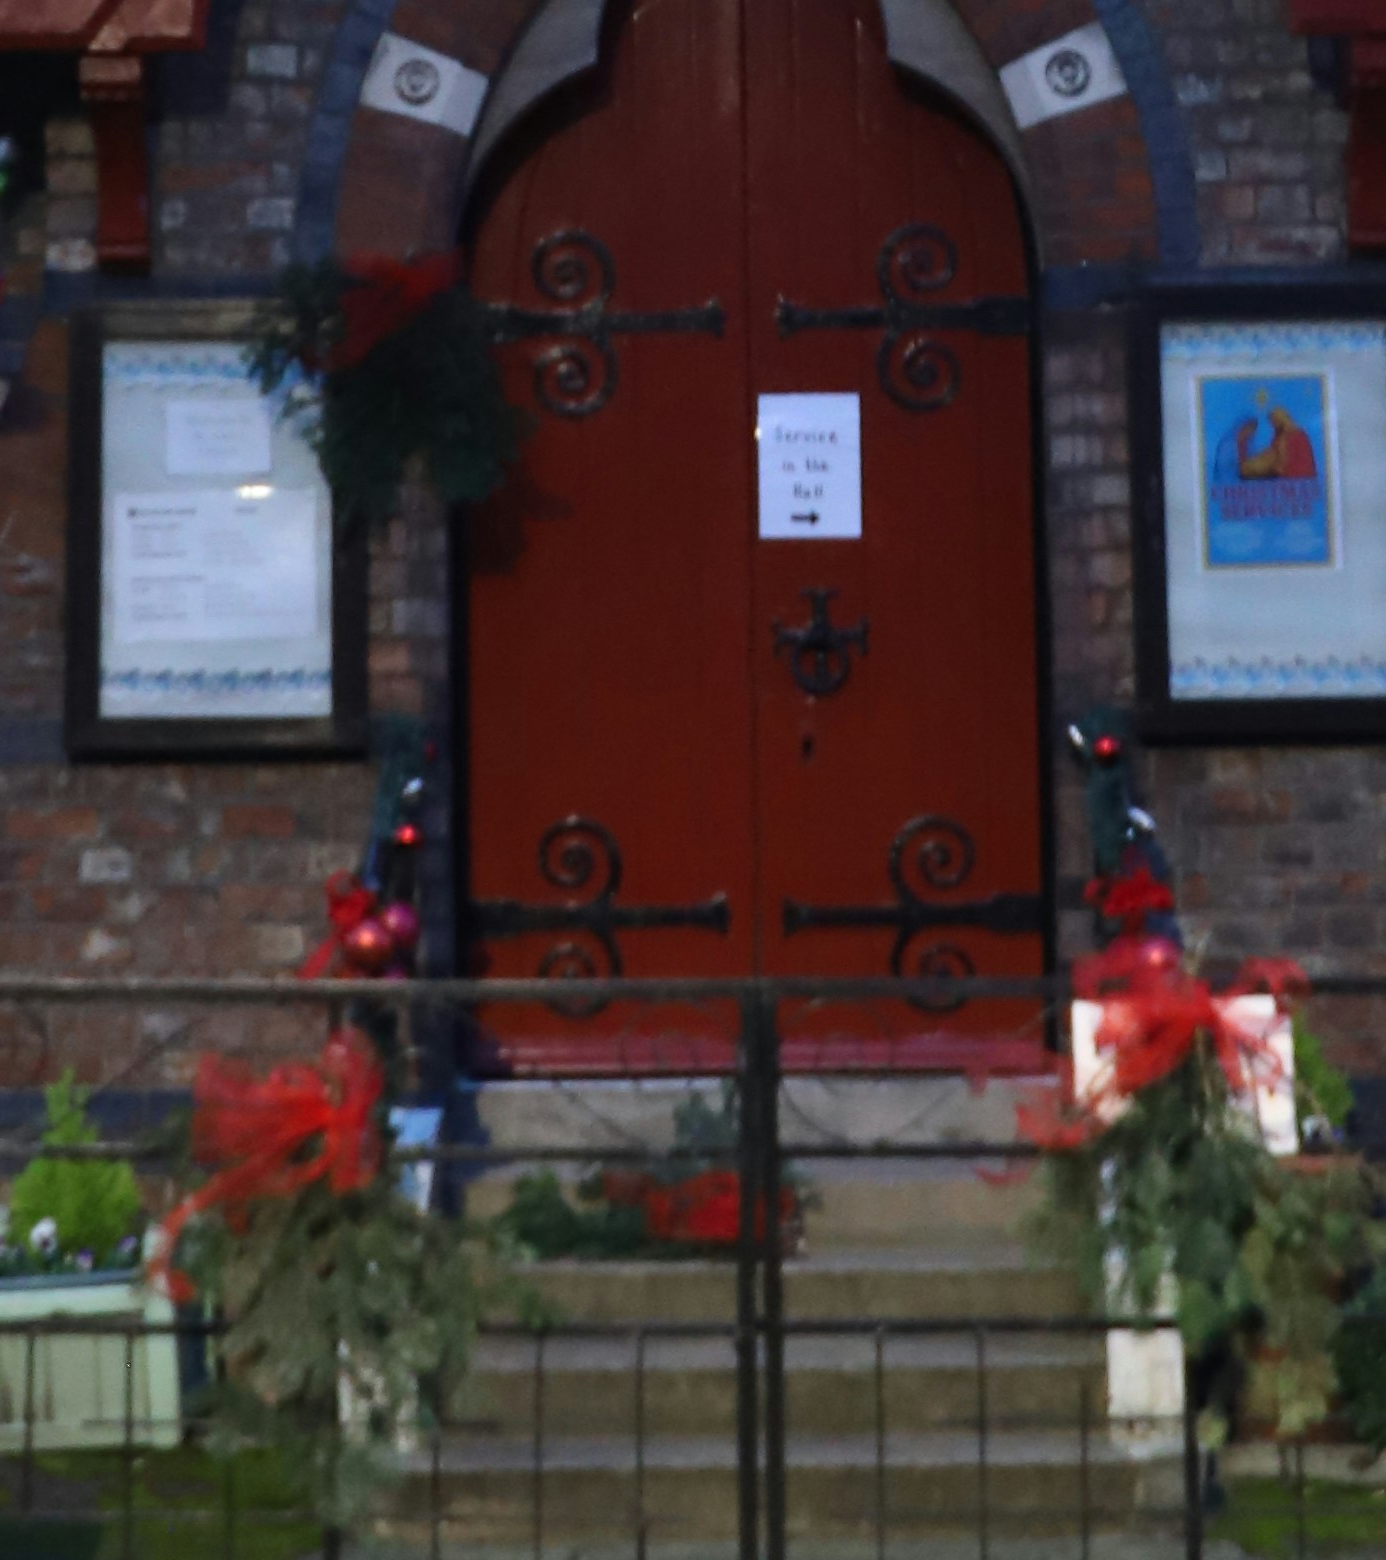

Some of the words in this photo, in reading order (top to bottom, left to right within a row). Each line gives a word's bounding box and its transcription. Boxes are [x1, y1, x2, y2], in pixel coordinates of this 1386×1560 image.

[775, 424, 838, 443] Service
[781, 459, 795, 471] in
[804, 455, 828, 471] the
[792, 479, 823, 497] Hall
